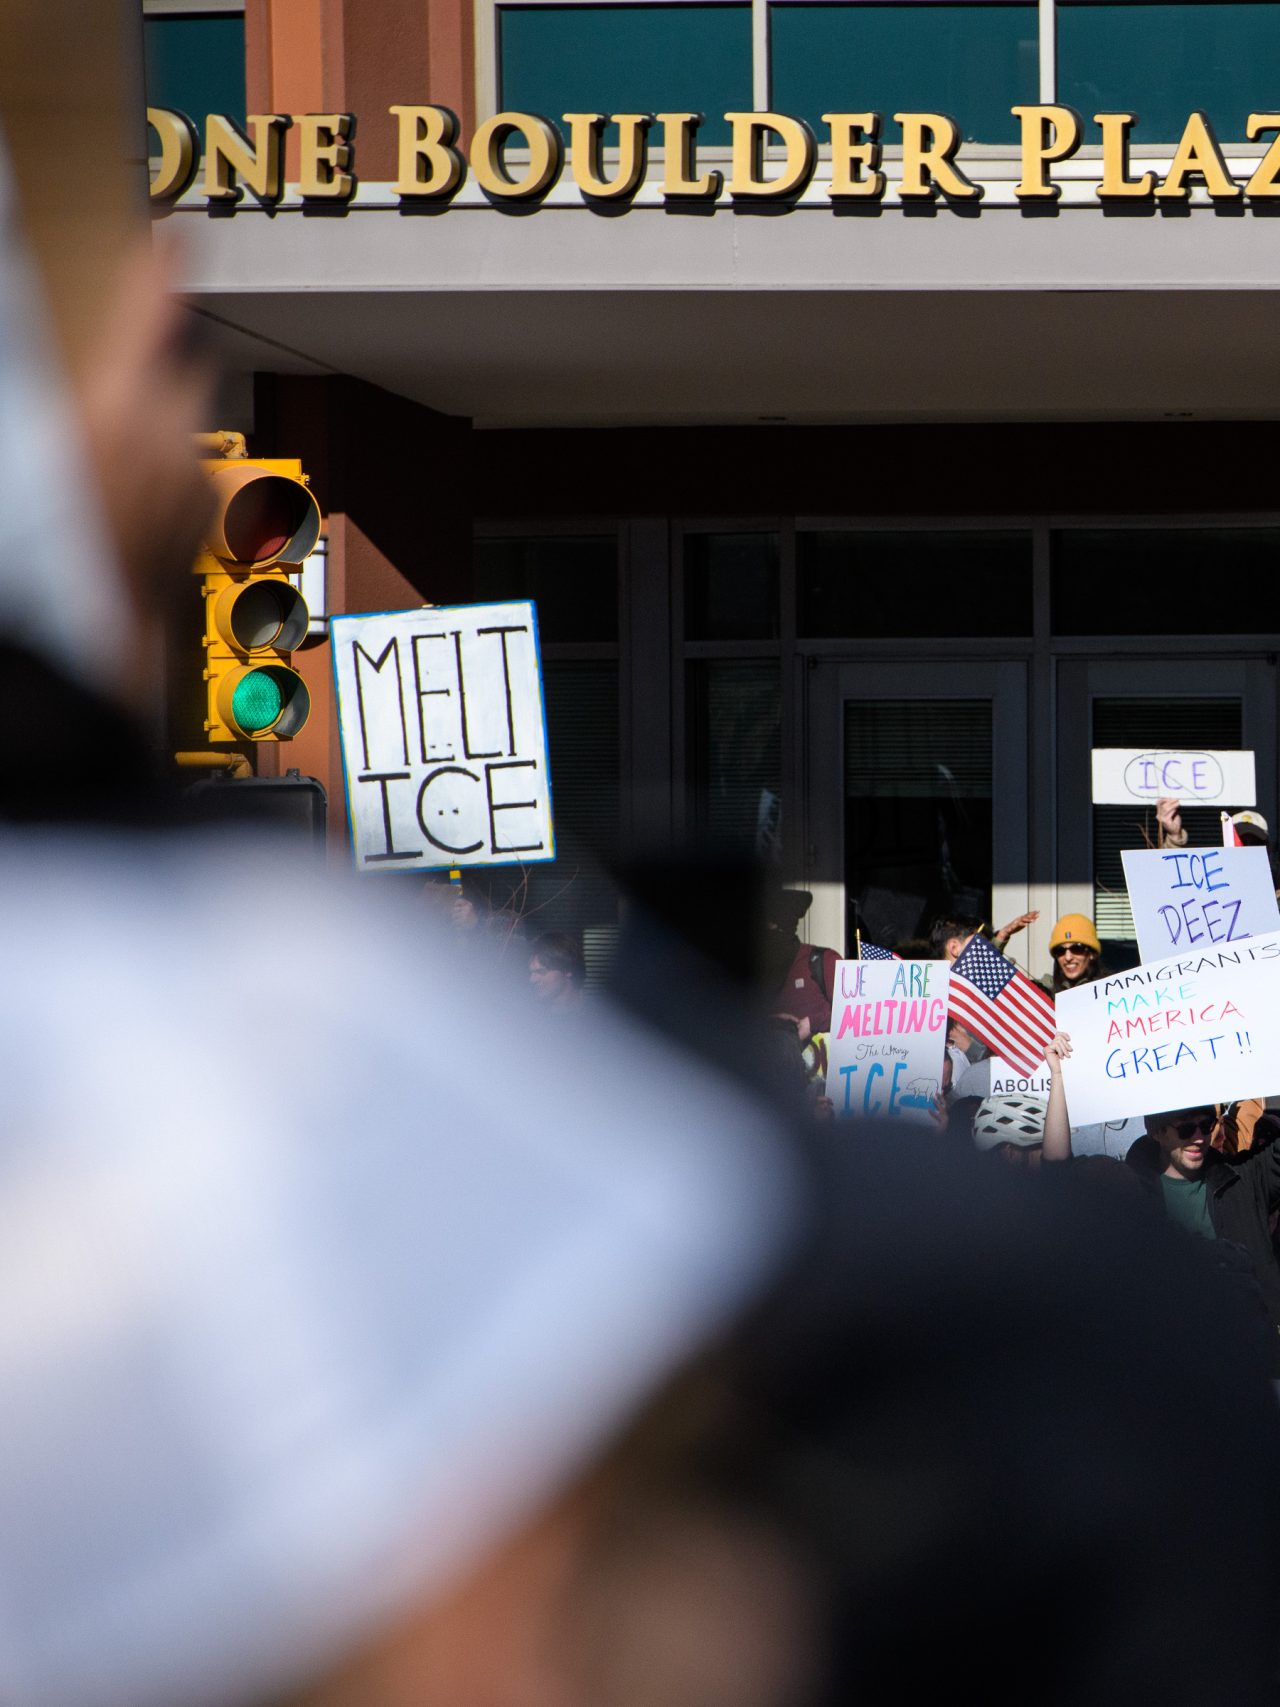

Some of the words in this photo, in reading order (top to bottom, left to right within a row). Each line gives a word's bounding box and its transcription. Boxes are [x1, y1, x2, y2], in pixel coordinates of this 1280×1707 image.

[389, 104, 984, 200] BOULDER
[352, 626, 528, 770] MELT
[1137, 760, 1208, 790] ICE
[358, 760, 544, 863] ICE
[1162, 851, 1230, 892] ICE
[1157, 898, 1253, 946] DEEZ
[842, 964, 868, 999] WE
[891, 963, 933, 997] ARE
[1107, 981, 1198, 1016] MAKE
[836, 999, 945, 1039] MELTING
[1107, 1000, 1245, 1044] AMERICA
[839, 1062, 908, 1119] ICE
